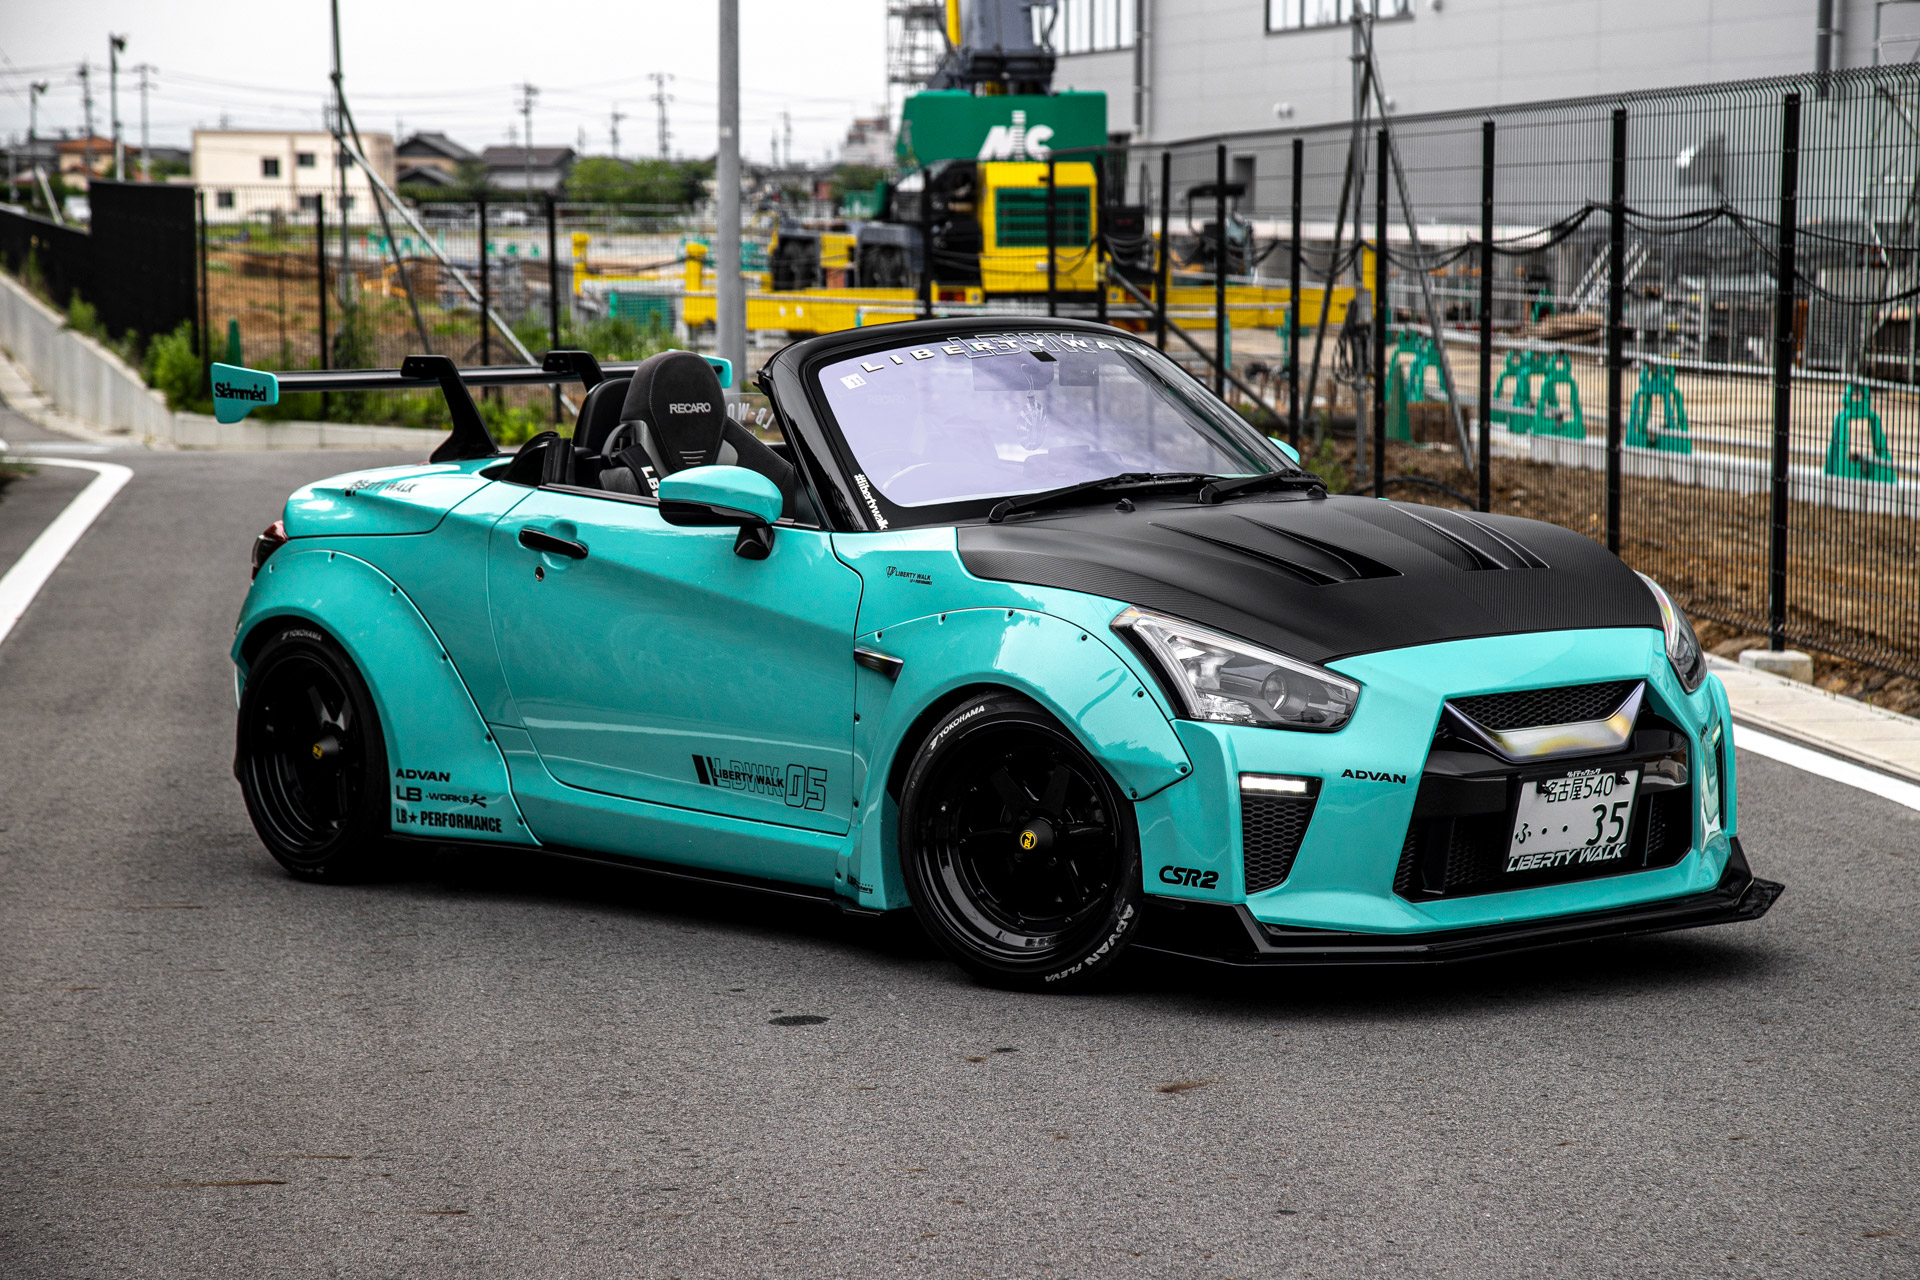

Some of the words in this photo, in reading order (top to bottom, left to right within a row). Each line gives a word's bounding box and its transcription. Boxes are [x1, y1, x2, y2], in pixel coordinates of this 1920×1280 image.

[860, 339, 1045, 373] LIBERTY
[1060, 339, 1158, 359] WALK
[669, 402, 711, 414] RECARO
[854, 473, 888, 530] #libertywalk
[895, 570, 916, 579] LIBERTY
[917, 573, 932, 581] WALK
[289, 629, 323, 642] YOKOHAMA
[939, 704, 986, 738] YOKOHAMA
[395, 767, 450, 783] ADVAN
[713, 767, 753, 784] LIBERTY
[756, 774, 785, 789] WALK
[1341, 769, 1407, 784] ADVAN
[396, 785, 423, 802] LB
[784, 763, 828, 812] 05
[420, 810, 502, 833] PERFORMANCE
[1585, 801, 1629, 846] 35
[1506, 849, 1579, 873] LIBERTY
[1578, 843, 1627, 863] WALK
[1159, 865, 1220, 890] CSR2
[1084, 903, 1135, 967] ADVAN
